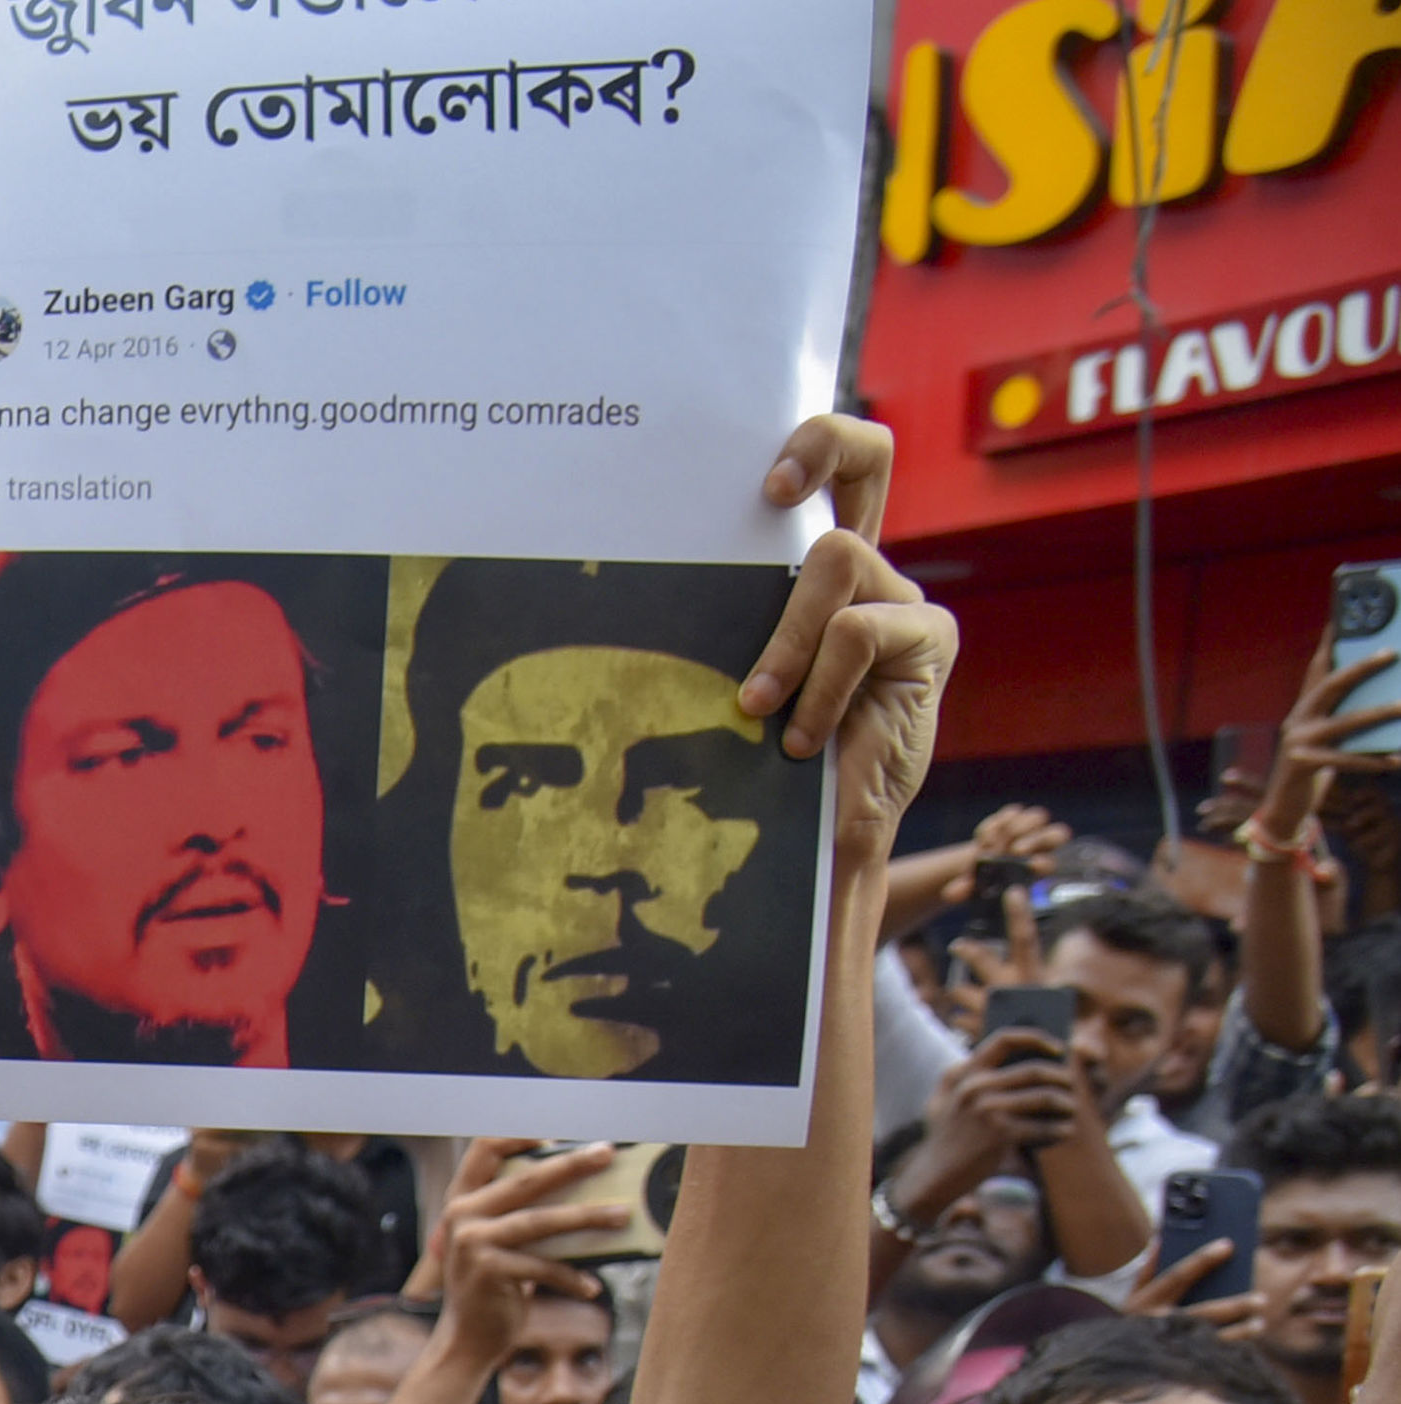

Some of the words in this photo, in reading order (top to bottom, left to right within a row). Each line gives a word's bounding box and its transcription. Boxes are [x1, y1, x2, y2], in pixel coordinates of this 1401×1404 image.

[65, 91, 179, 152] ভয়
[206, 47, 697, 150] তোমালোকৰ?
[43, 287, 155, 316] Zubeen
[164, 284, 235, 316] Garg
[306, 278, 407, 309] Follow
[44, 338, 70, 361] 12
[77, 338, 117, 363] Apr
[123, 335, 179, 359] 2016
[1066, 283, 1401, 424] FLAVOU
[61, 397, 170, 431] change
[180, 394, 477, 433] evrythng.goodmrng
[487, 395, 640, 427] comrades
[6, 474, 151, 501] translation
